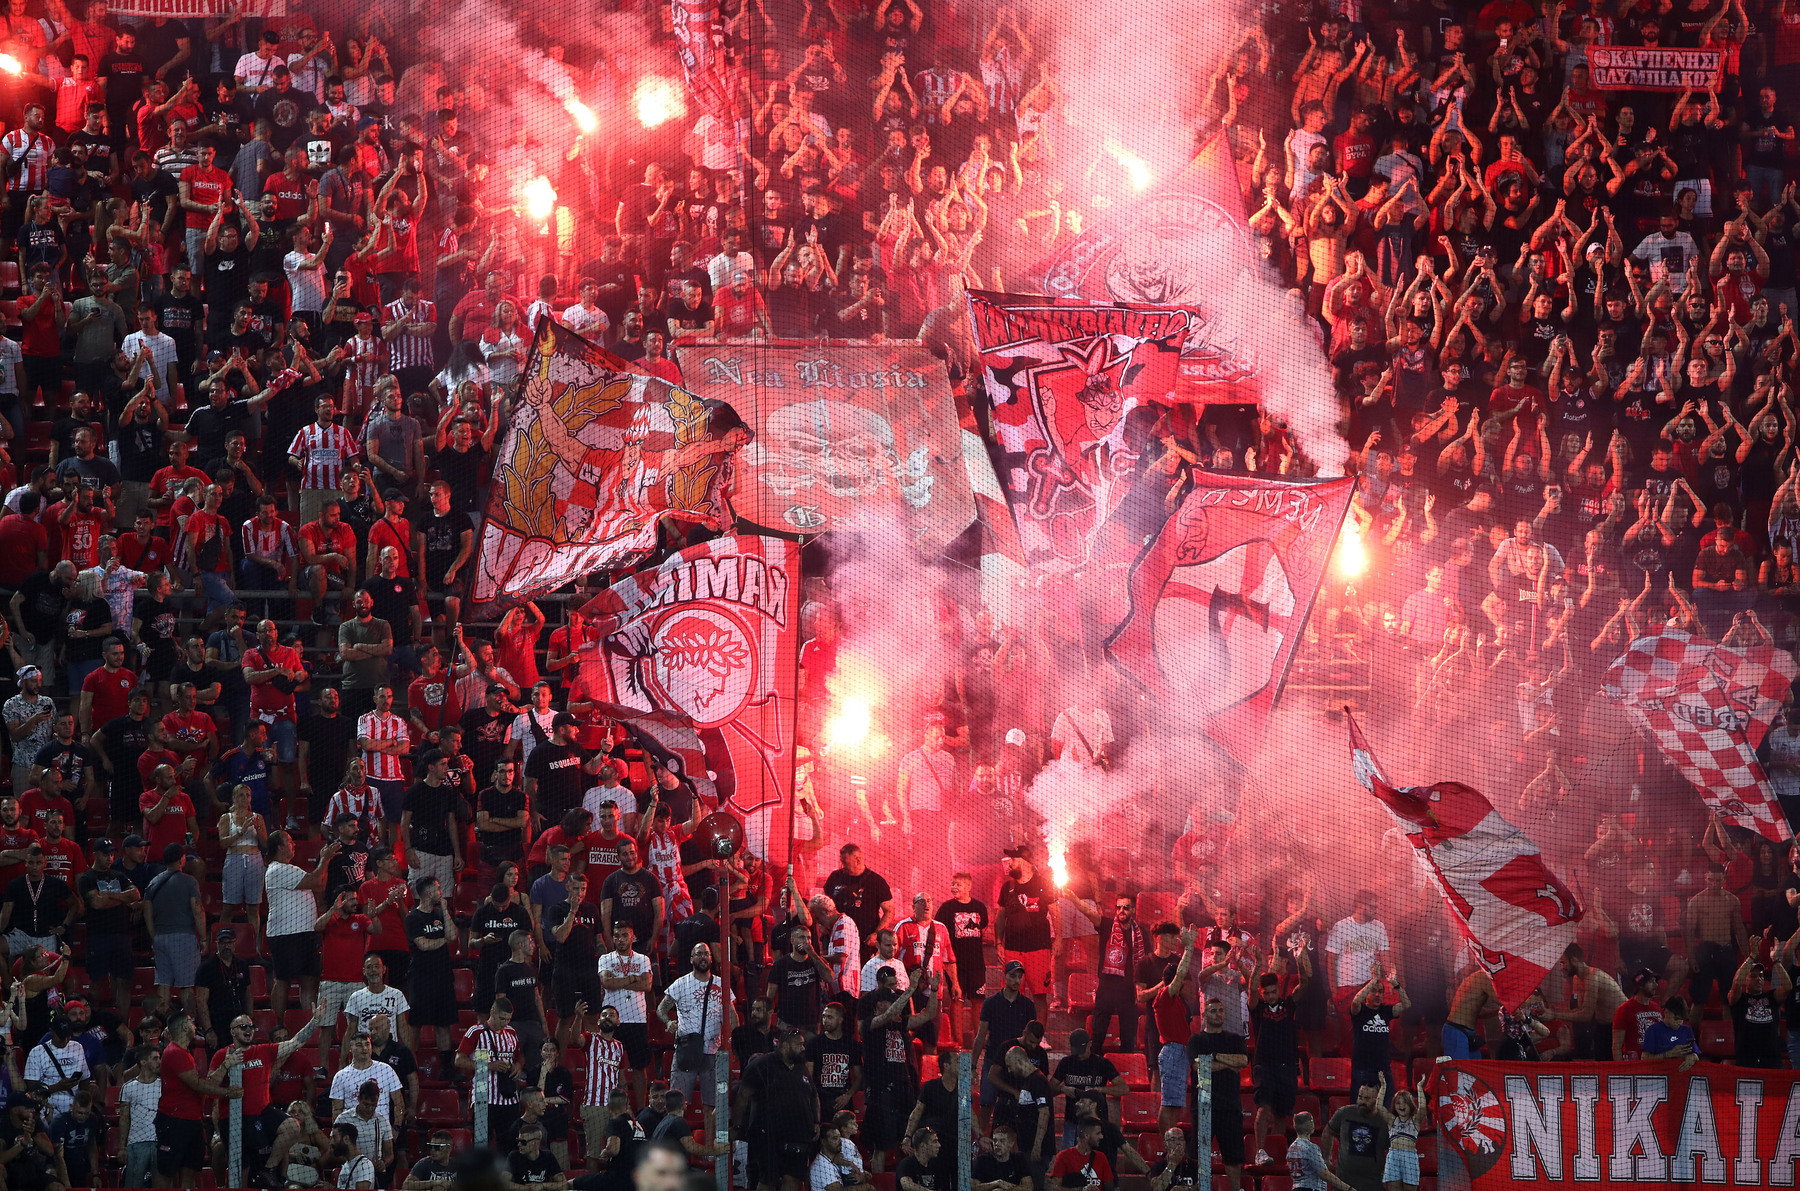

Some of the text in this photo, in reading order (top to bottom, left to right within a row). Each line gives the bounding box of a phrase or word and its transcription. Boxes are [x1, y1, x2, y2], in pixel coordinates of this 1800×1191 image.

[279, 191, 302, 200] adida
[590, 853, 620, 864] PIRAEUS
[485, 920, 518, 929] ellesse
[385, 998, 396, 1007] 77
[1363, 1023, 1390, 1033] adidas
[823, 1054, 849, 1064] BORN
[821, 1074, 848, 1084] FIGHT
